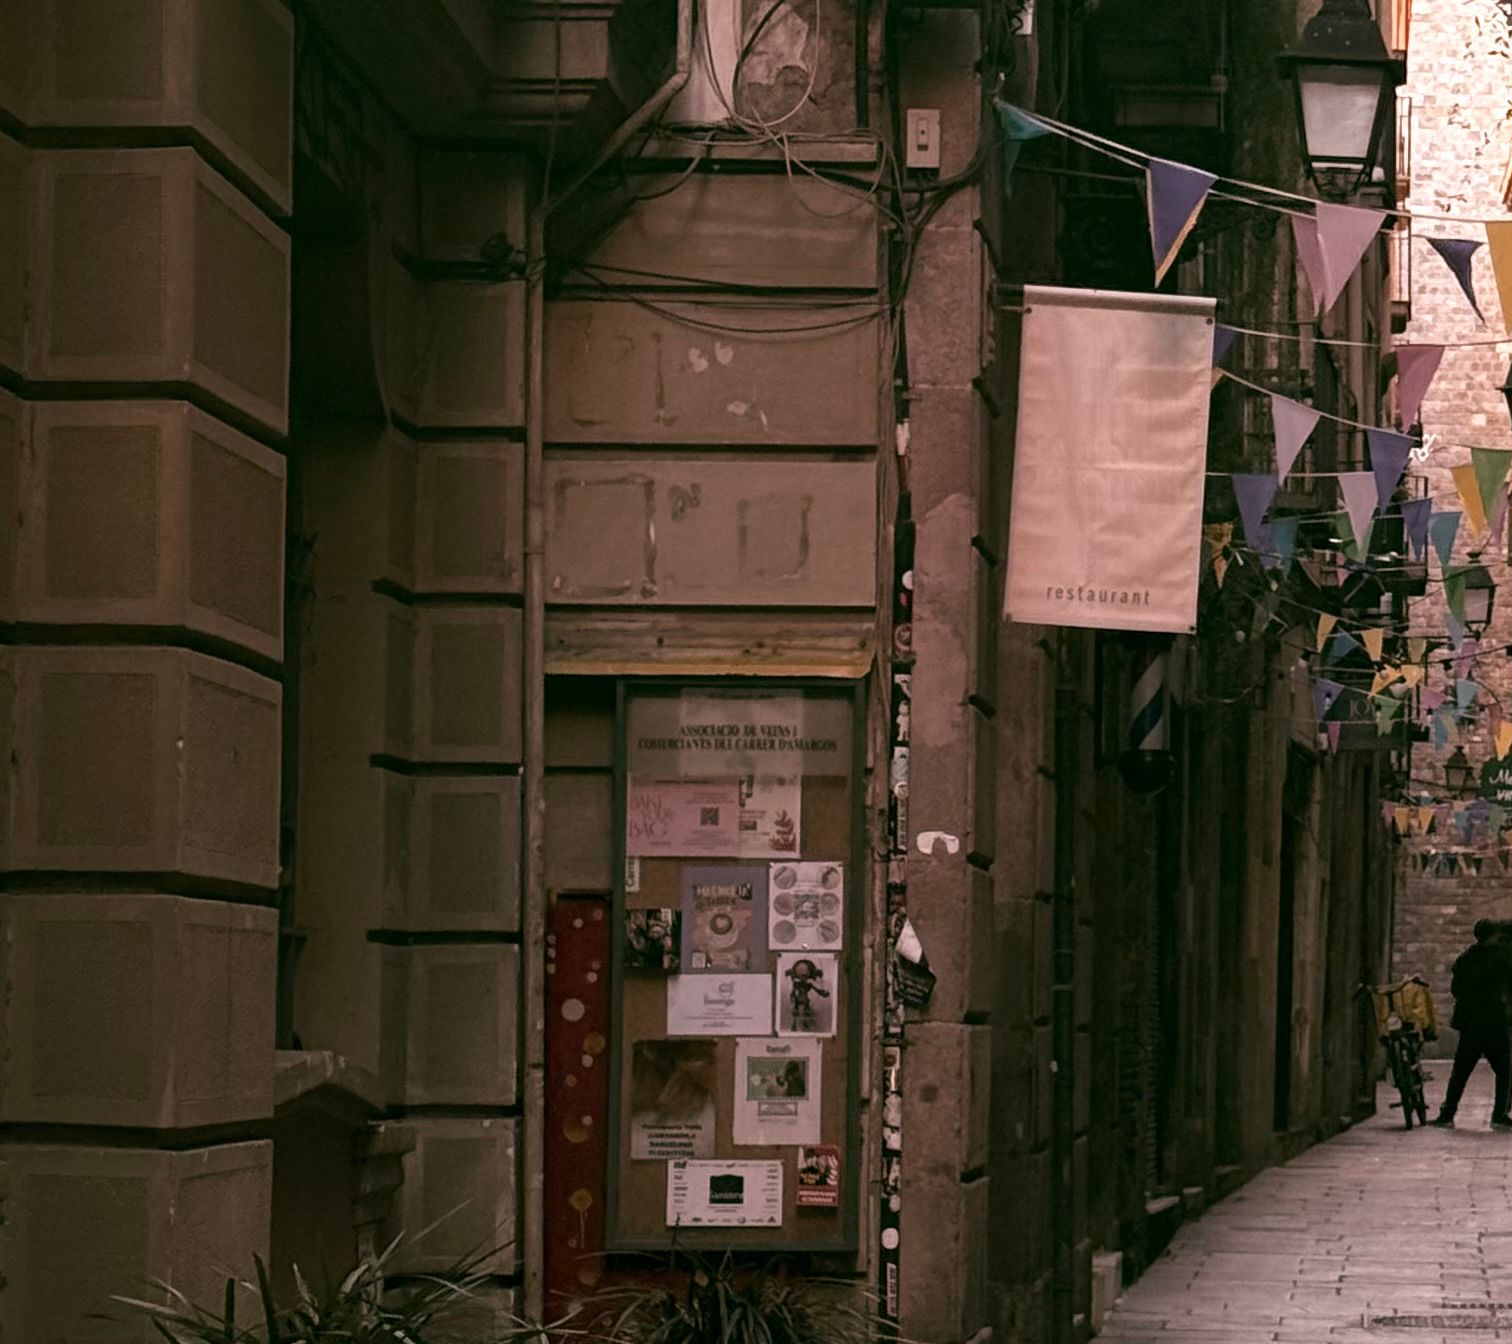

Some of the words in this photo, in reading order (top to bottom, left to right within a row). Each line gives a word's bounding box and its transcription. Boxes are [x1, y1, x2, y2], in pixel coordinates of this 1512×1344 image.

[1046, 586, 1150, 606] restaurant
[714, 738, 733, 751] DEL
[735, 738, 777, 752] CARRER
